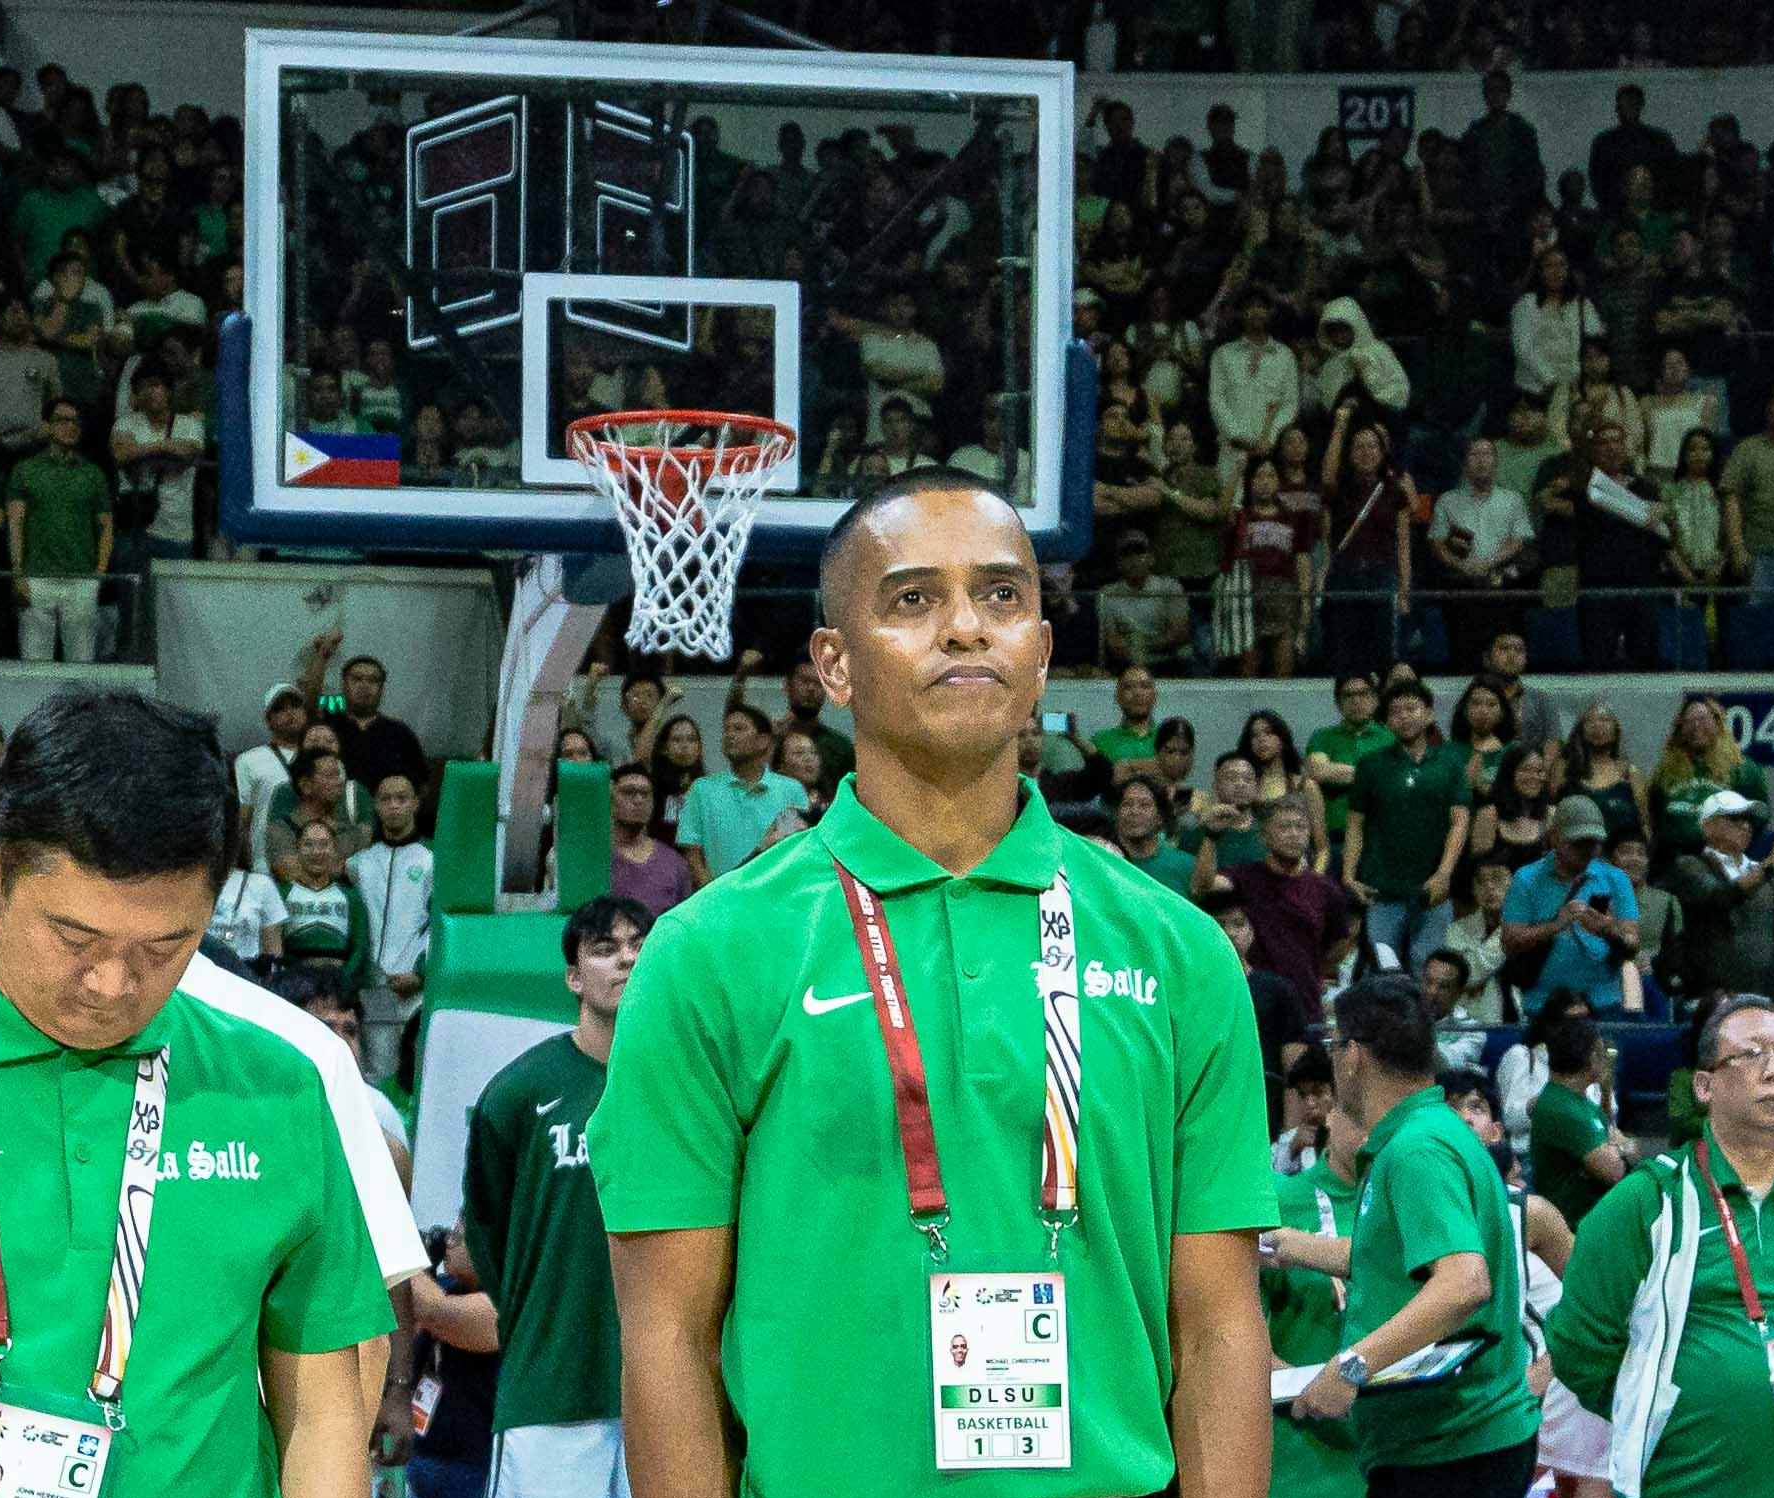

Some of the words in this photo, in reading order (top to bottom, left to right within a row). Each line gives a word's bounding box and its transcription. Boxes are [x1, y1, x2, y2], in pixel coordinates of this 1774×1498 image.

[1345, 95, 1410, 129] 201
[1083, 959, 1158, 1005] Salle
[187, 1139, 261, 1181] Salle
[1032, 1313, 1051, 1339] C
[969, 1387, 1034, 1403] DLSU
[957, 1416, 1049, 1430] BASKETBALL
[974, 1437, 983, 1455] 1
[1022, 1436, 1033, 1454] 3
[68, 1462, 89, 1488] C
